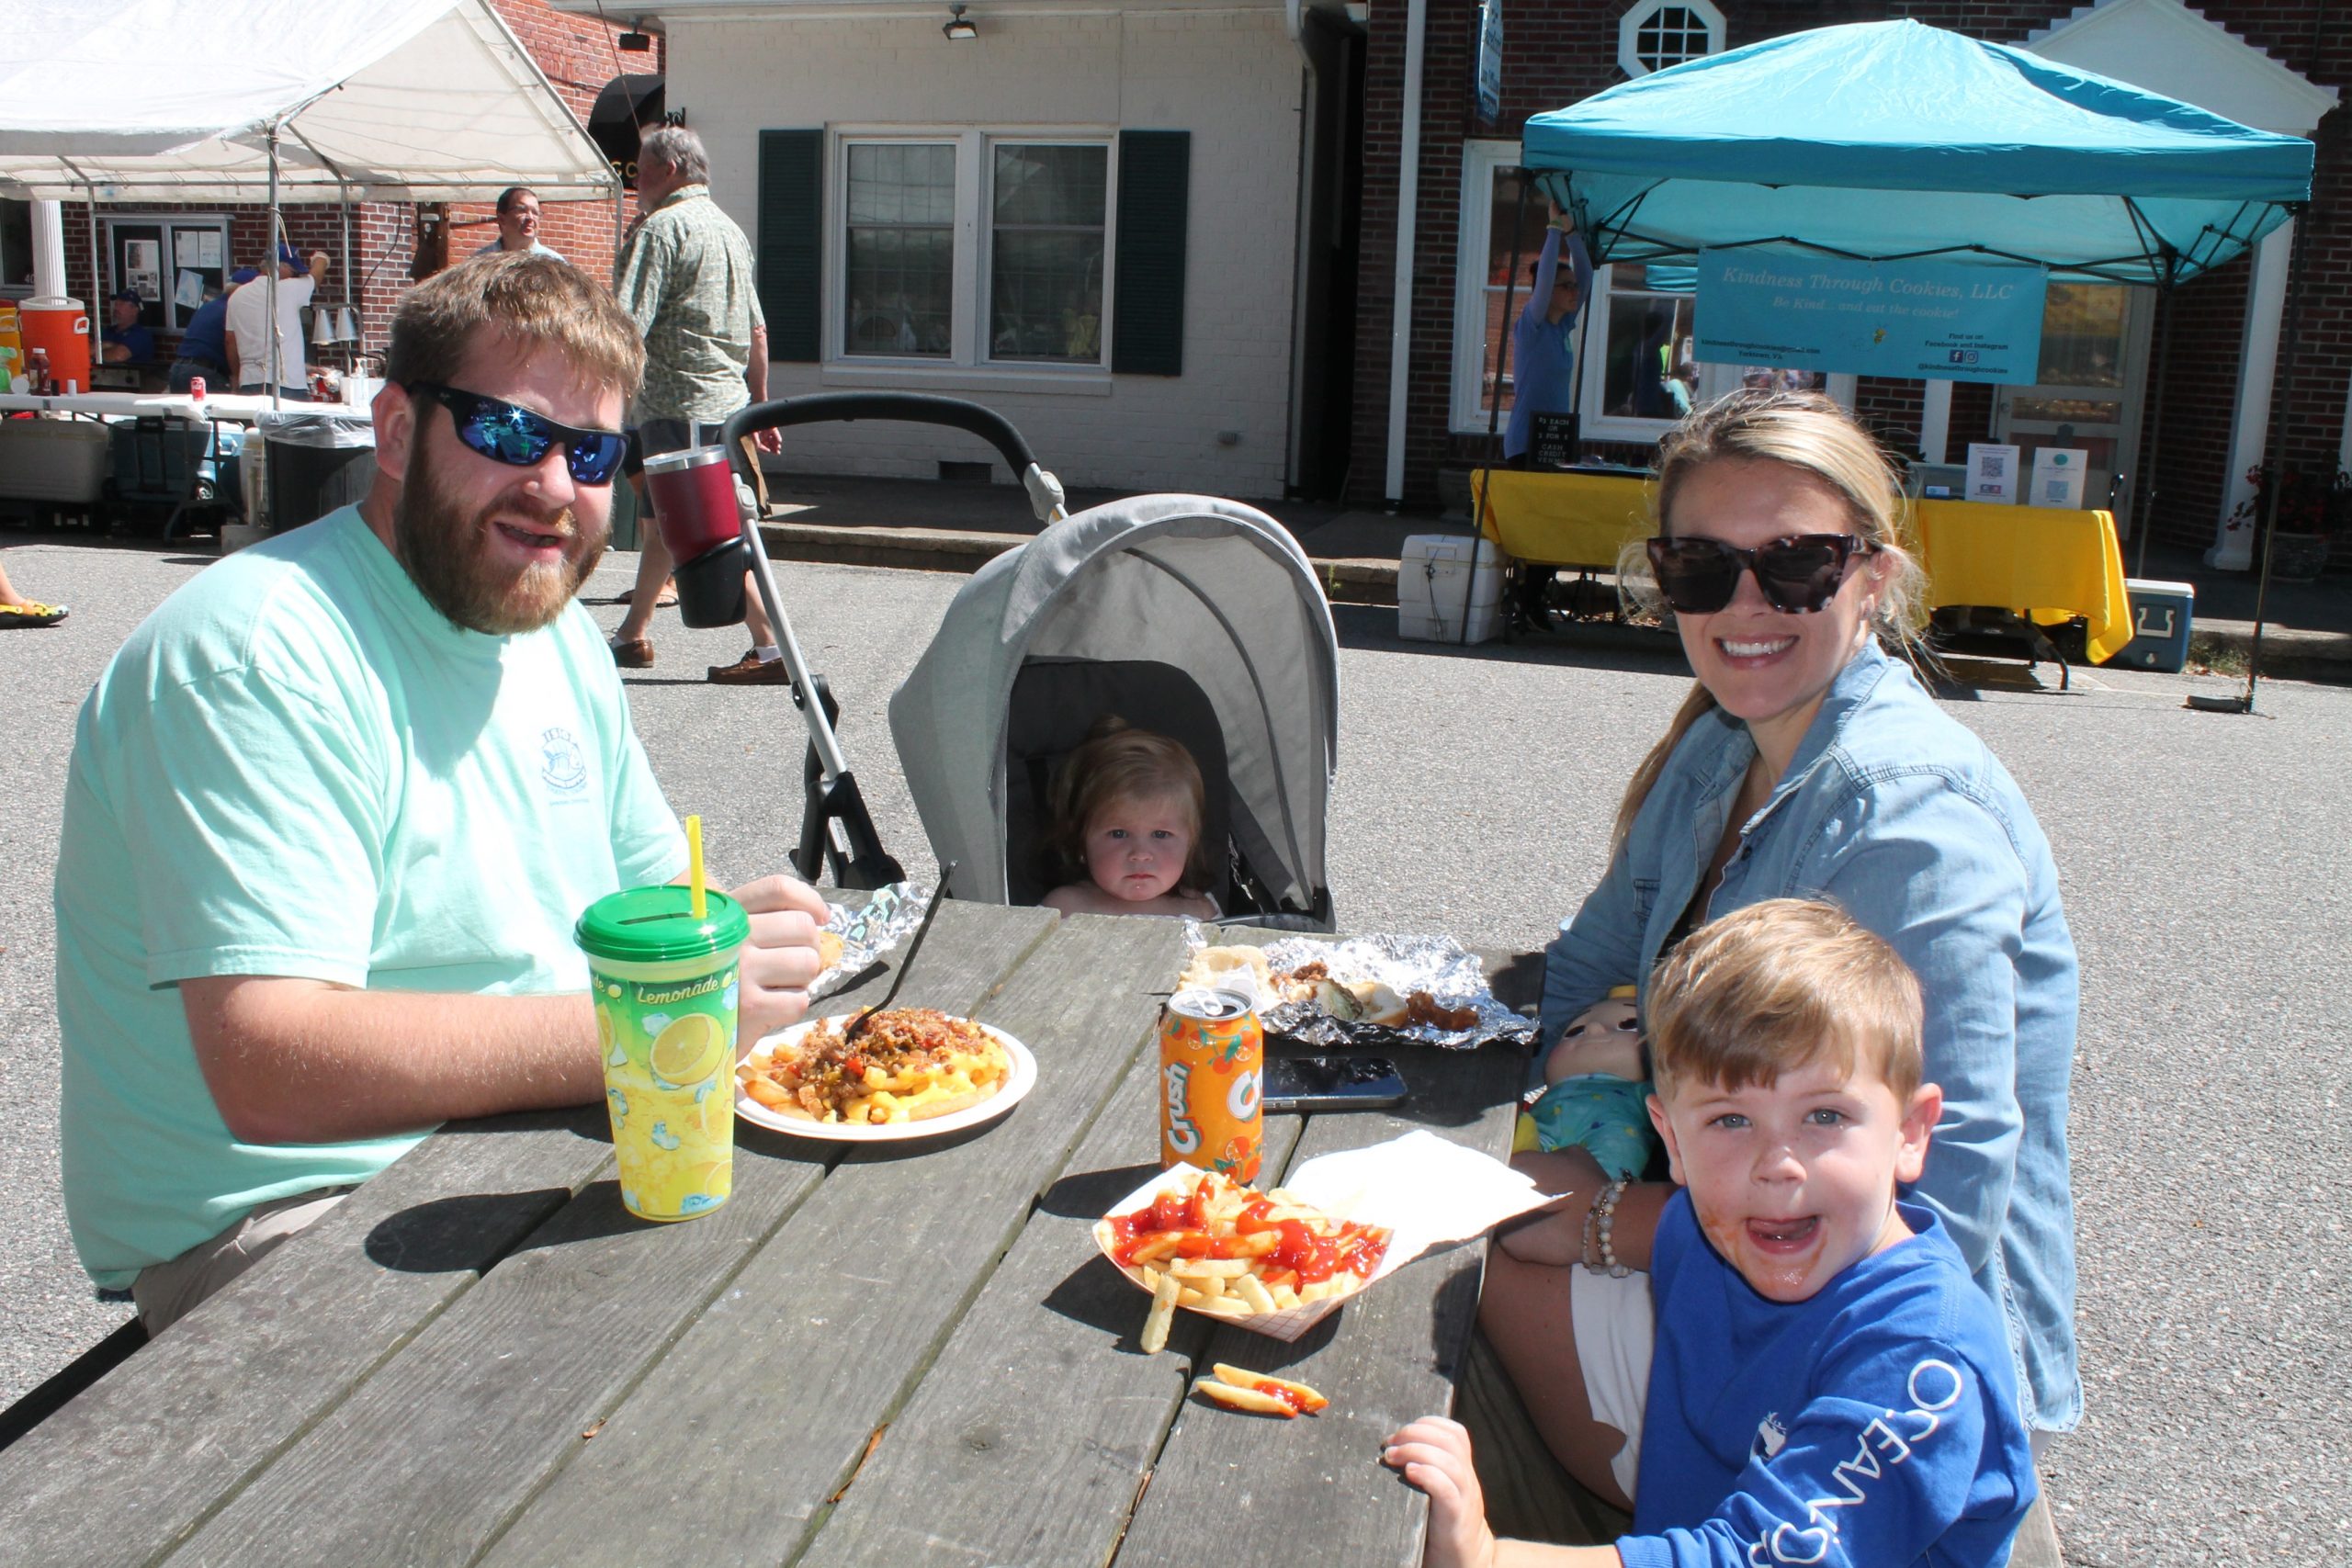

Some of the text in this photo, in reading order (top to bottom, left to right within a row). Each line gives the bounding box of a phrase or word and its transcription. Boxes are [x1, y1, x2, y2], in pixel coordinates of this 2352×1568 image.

[1723, 266, 2014, 299] Kindness Through Cookies, LLC
[1773, 297, 1790, 308] Be
[1838, 300, 1862, 312] and
[1866, 304, 1885, 313] eat
[1889, 304, 1910, 315] the
[1912, 306, 1960, 319] cookie!
[1925, 340, 1958, 348] Facebook
[1973, 343, 2008, 351] Instagram
[638, 974, 719, 1004] Lemonade
[1164, 1062, 1201, 1156] Crush
[1805, 1359, 1962, 1533] OCEAN
